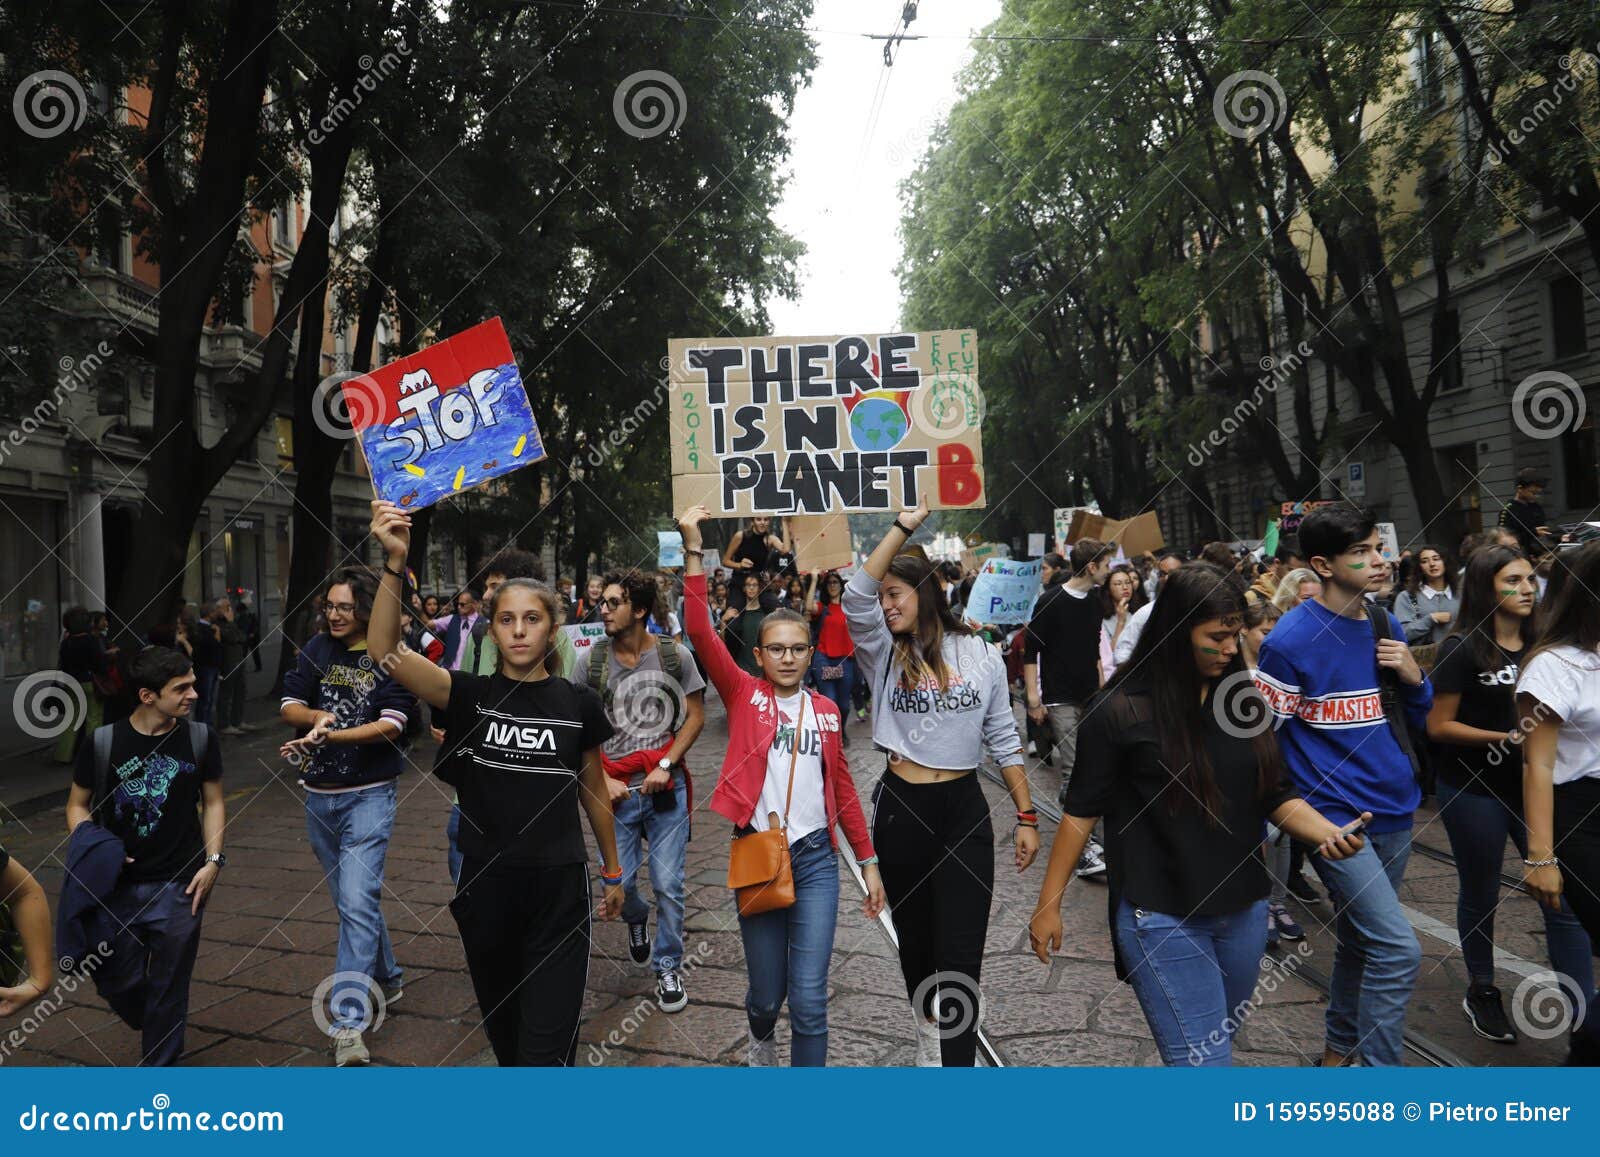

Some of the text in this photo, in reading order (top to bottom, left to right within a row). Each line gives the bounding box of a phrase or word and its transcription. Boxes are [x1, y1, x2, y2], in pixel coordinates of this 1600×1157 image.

[688, 334, 920, 405] THERE
[384, 368, 505, 471] STOP
[682, 392, 701, 470] 2019
[712, 405, 768, 455] IS
[720, 442, 983, 513] PLANET B
[485, 721, 557, 751] NASA
[935, 689, 982, 713] ROCK
